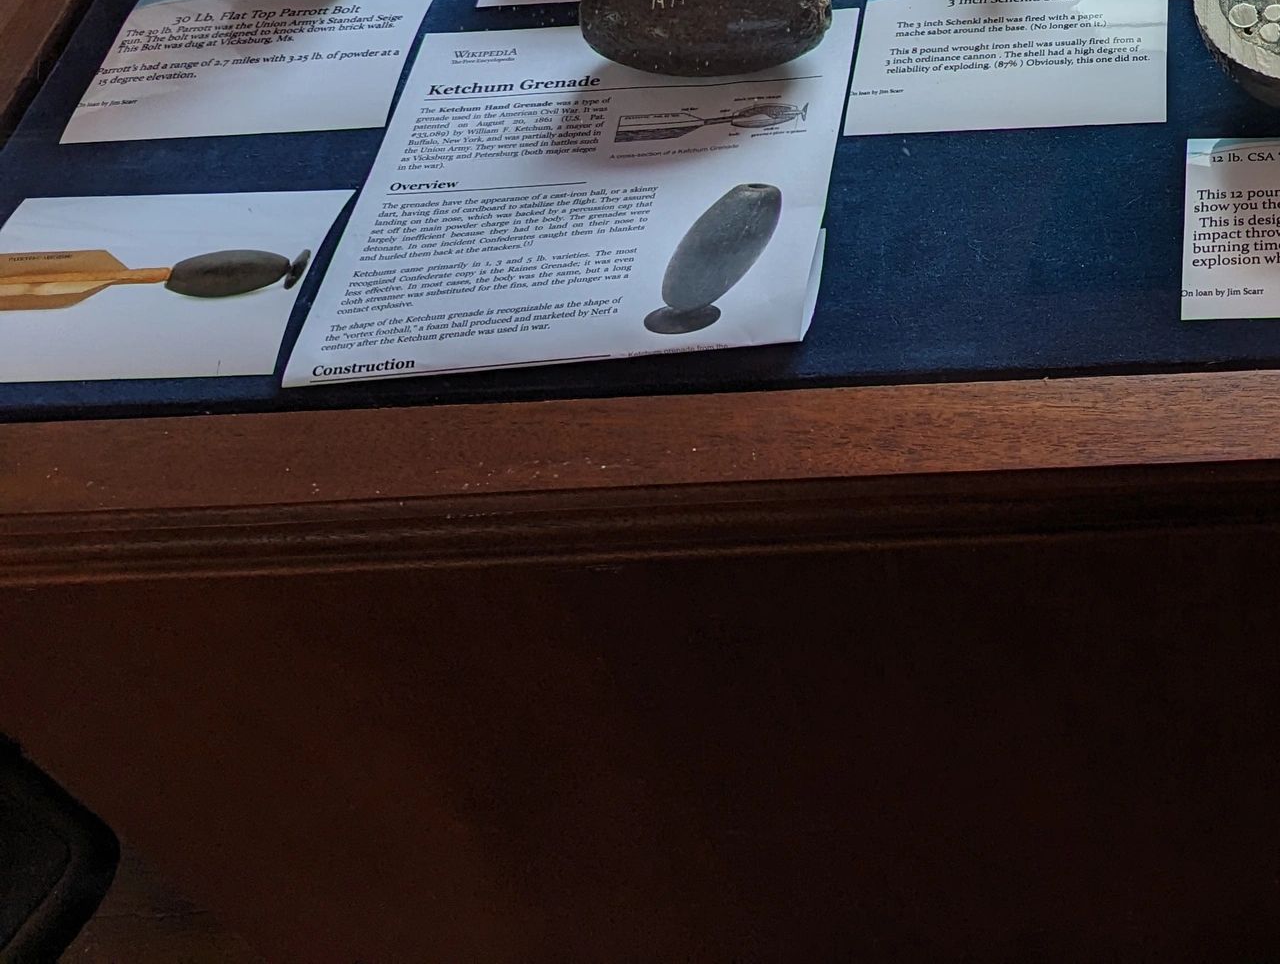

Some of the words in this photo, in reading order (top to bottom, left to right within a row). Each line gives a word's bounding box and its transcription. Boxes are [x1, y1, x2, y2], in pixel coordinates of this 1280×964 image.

[194, 13, 215, 22] Lb.
[218, 10, 248, 21] Flat
[249, 8, 276, 22] Top
[278, 5, 330, 18] Parrott
[329, 4, 362, 15] Bolt
[895, 28, 925, 37] mache
[926, 26, 951, 36] sabot
[952, 25, 985, 34] around
[987, 24, 1003, 33] the
[1004, 23, 1027, 32] base.
[1048, 20, 1078, 32] longer
[896, 19, 914, 28] The
[915, 21, 921, 30] 3
[923, 18, 943, 27] inch
[944, 16, 981, 26] Schenkl
[982, 15, 1004, 24] shell
[1024, 14, 1045, 23] fired
[1047, 12, 1069, 22] with
[1076, 13, 1103, 23] paper
[454, 48, 518, 58] WIKIPEDIA
[109, 73, 145, 85] degree
[146, 70, 197, 81] elevation.
[427, 80, 513, 95] Ketchum
[519, 76, 601, 90] Grenade
[1212, 155, 1223, 163] 12
[1227, 151, 1242, 162] lb.
[1247, 151, 1275, 162] CSA
[390, 180, 459, 192] Overview
[1196, 187, 1226, 200] This
[1229, 190, 1243, 199] 12
[1193, 200, 1230, 213] show
[1232, 203, 1258, 215] you
[1198, 215, 1229, 228] This
[1233, 215, 1244, 227] is
[1192, 228, 1242, 244] impact
[1192, 240, 1250, 257] burning
[1191, 253, 1261, 270] explosion
[1181, 288, 1193, 297] On
[1194, 288, 1213, 297] loan
[1214, 287, 1226, 299] by
[1226, 287, 1241, 296] Jim
[1242, 286, 1264, 295] Scarr
[312, 358, 415, 377] Construction
